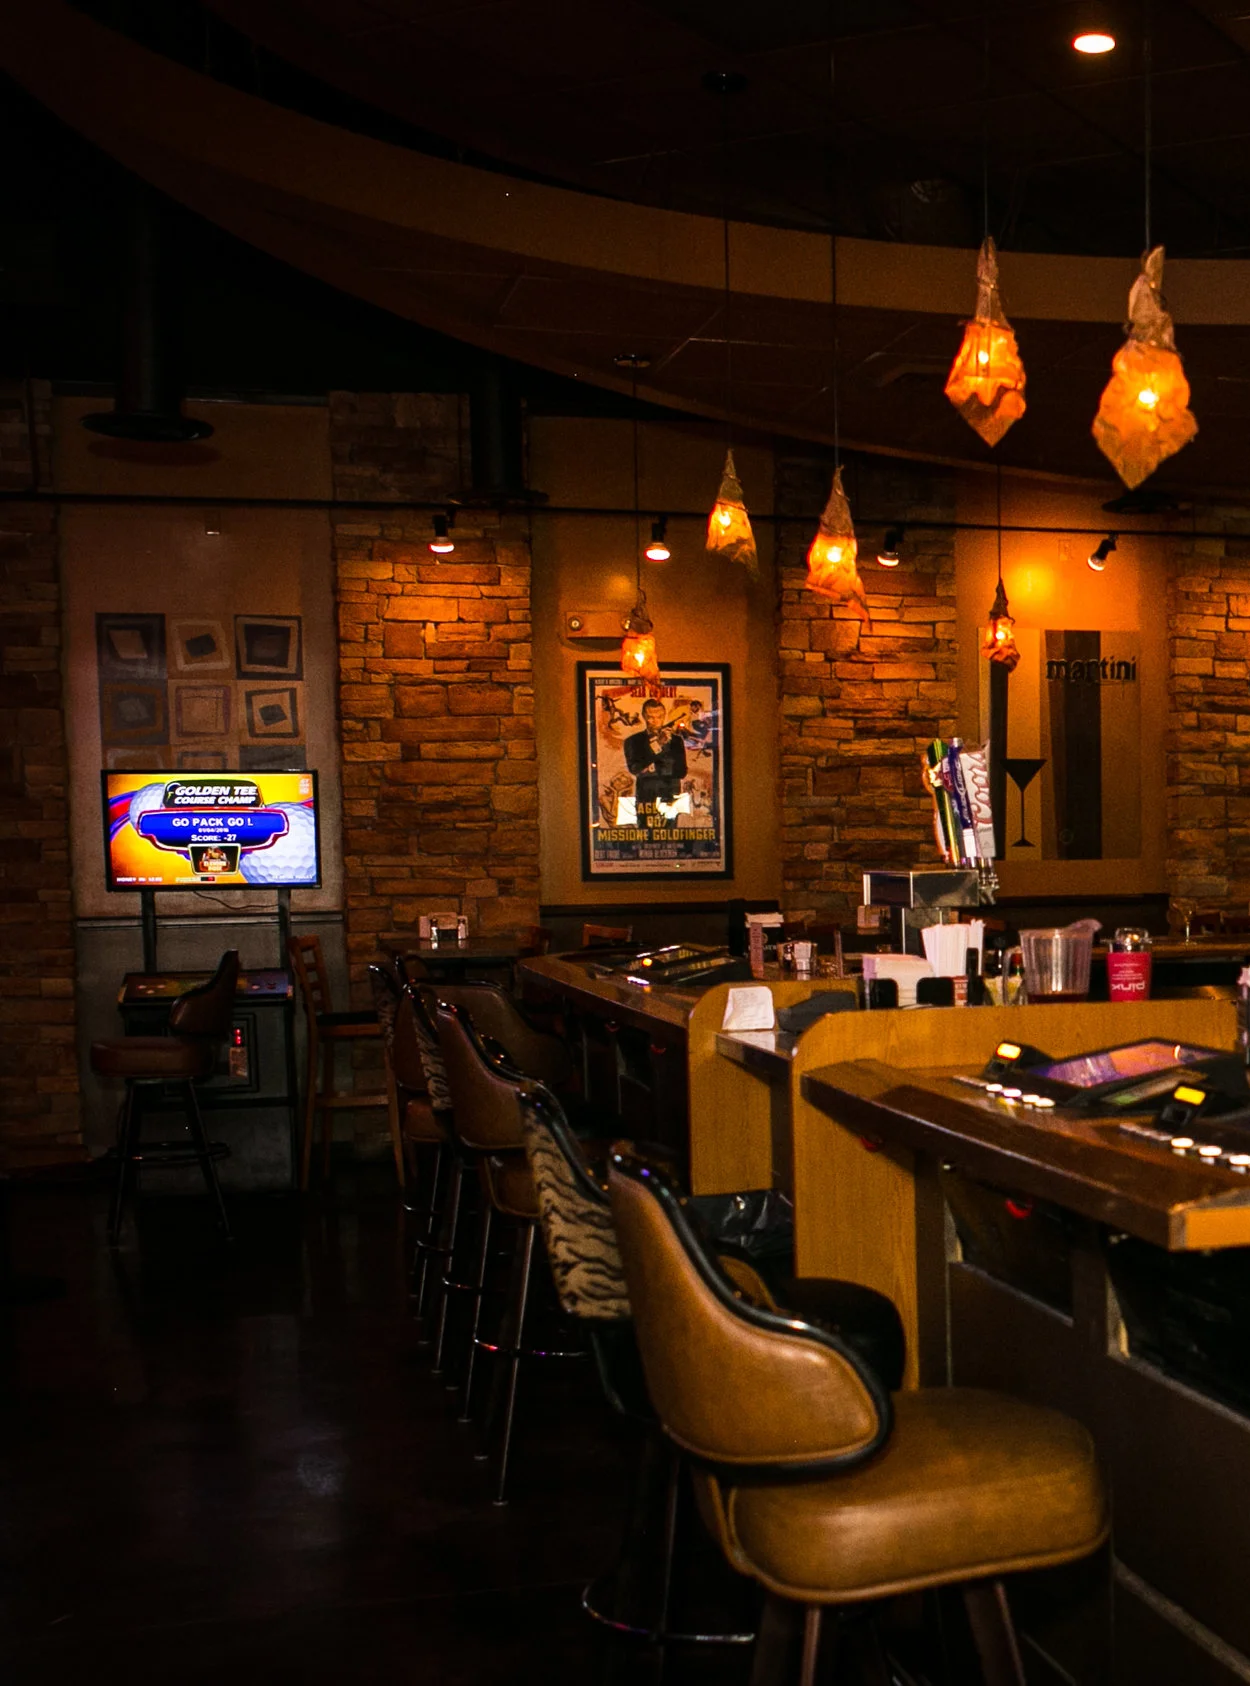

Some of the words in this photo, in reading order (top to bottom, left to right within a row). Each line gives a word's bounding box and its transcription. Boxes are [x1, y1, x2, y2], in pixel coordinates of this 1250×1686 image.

[1046, 656, 1137, 681] martini
[175, 786, 231, 796] GOLDEN
[234, 786, 258, 795] TEE
[174, 796, 217, 804] COURSE
[218, 796, 256, 804] CHAMP
[172, 818, 190, 827] GO
[192, 818, 224, 827] PACK
[227, 818, 244, 826] GO
[598, 829, 649, 841] MISSIONE
[653, 829, 716, 840] GOLDFINGER
